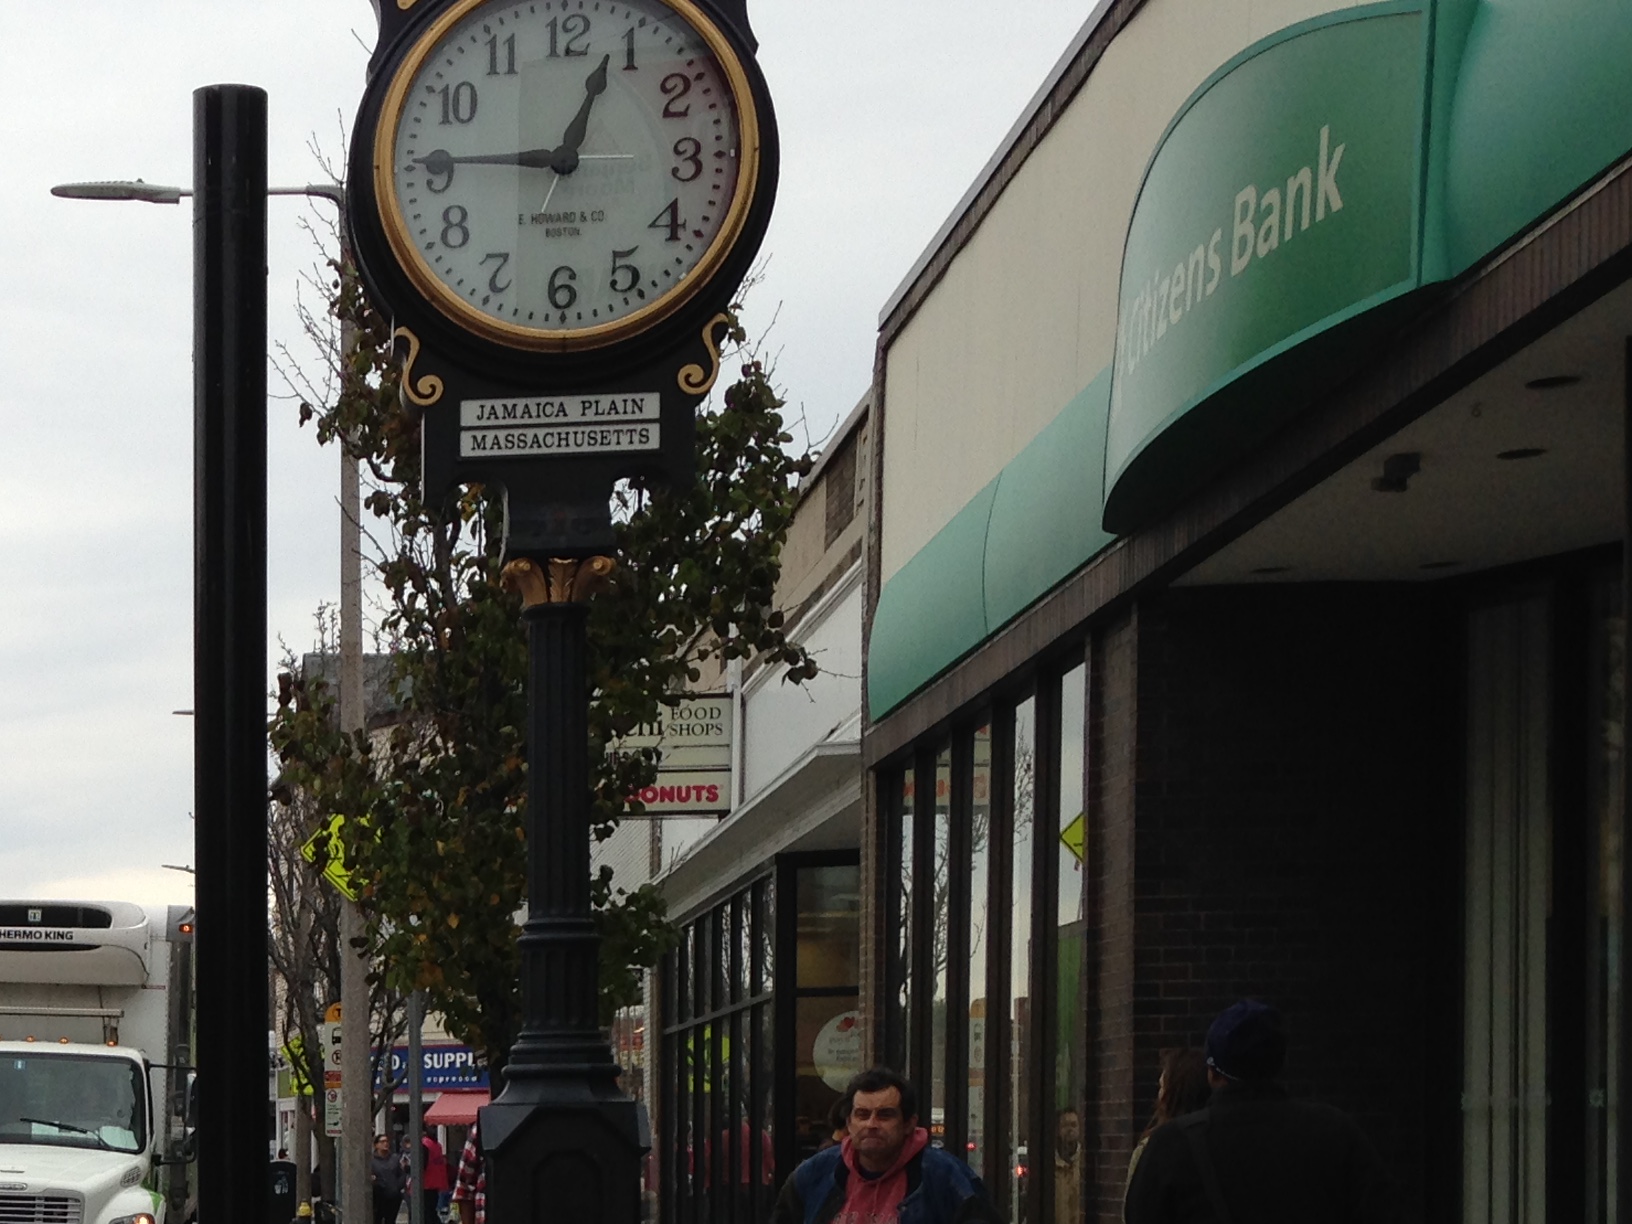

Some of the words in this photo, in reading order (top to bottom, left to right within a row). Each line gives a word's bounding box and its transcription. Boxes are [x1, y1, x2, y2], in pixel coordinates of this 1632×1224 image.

[484, 33, 519, 76] 11
[545, 13, 591, 58] 12
[621, 26, 639, 71] 1
[437, 81, 478, 125] 10
[659, 72, 692, 118] 2
[670, 137, 703, 182] 3
[531, 212, 576, 225] HOWARD
[579, 211, 588, 223] &
[646, 197, 687, 242] 4
[1231, 124, 1346, 278] Bank
[440, 204, 470, 249] 8
[479, 253, 512, 293] 7
[547, 265, 577, 310] 6
[609, 245, 640, 293] 5
[477, 401, 568, 421] JAMAICA
[580, 398, 645, 417] PLAIN
[471, 428, 650, 451] MASSACHUSETTS
[669, 723, 723, 737] SHOPS
[671, 706, 721, 720] FOOD
[44, 930, 74, 940] KING
[424, 1052, 479, 1070] SUPPL
